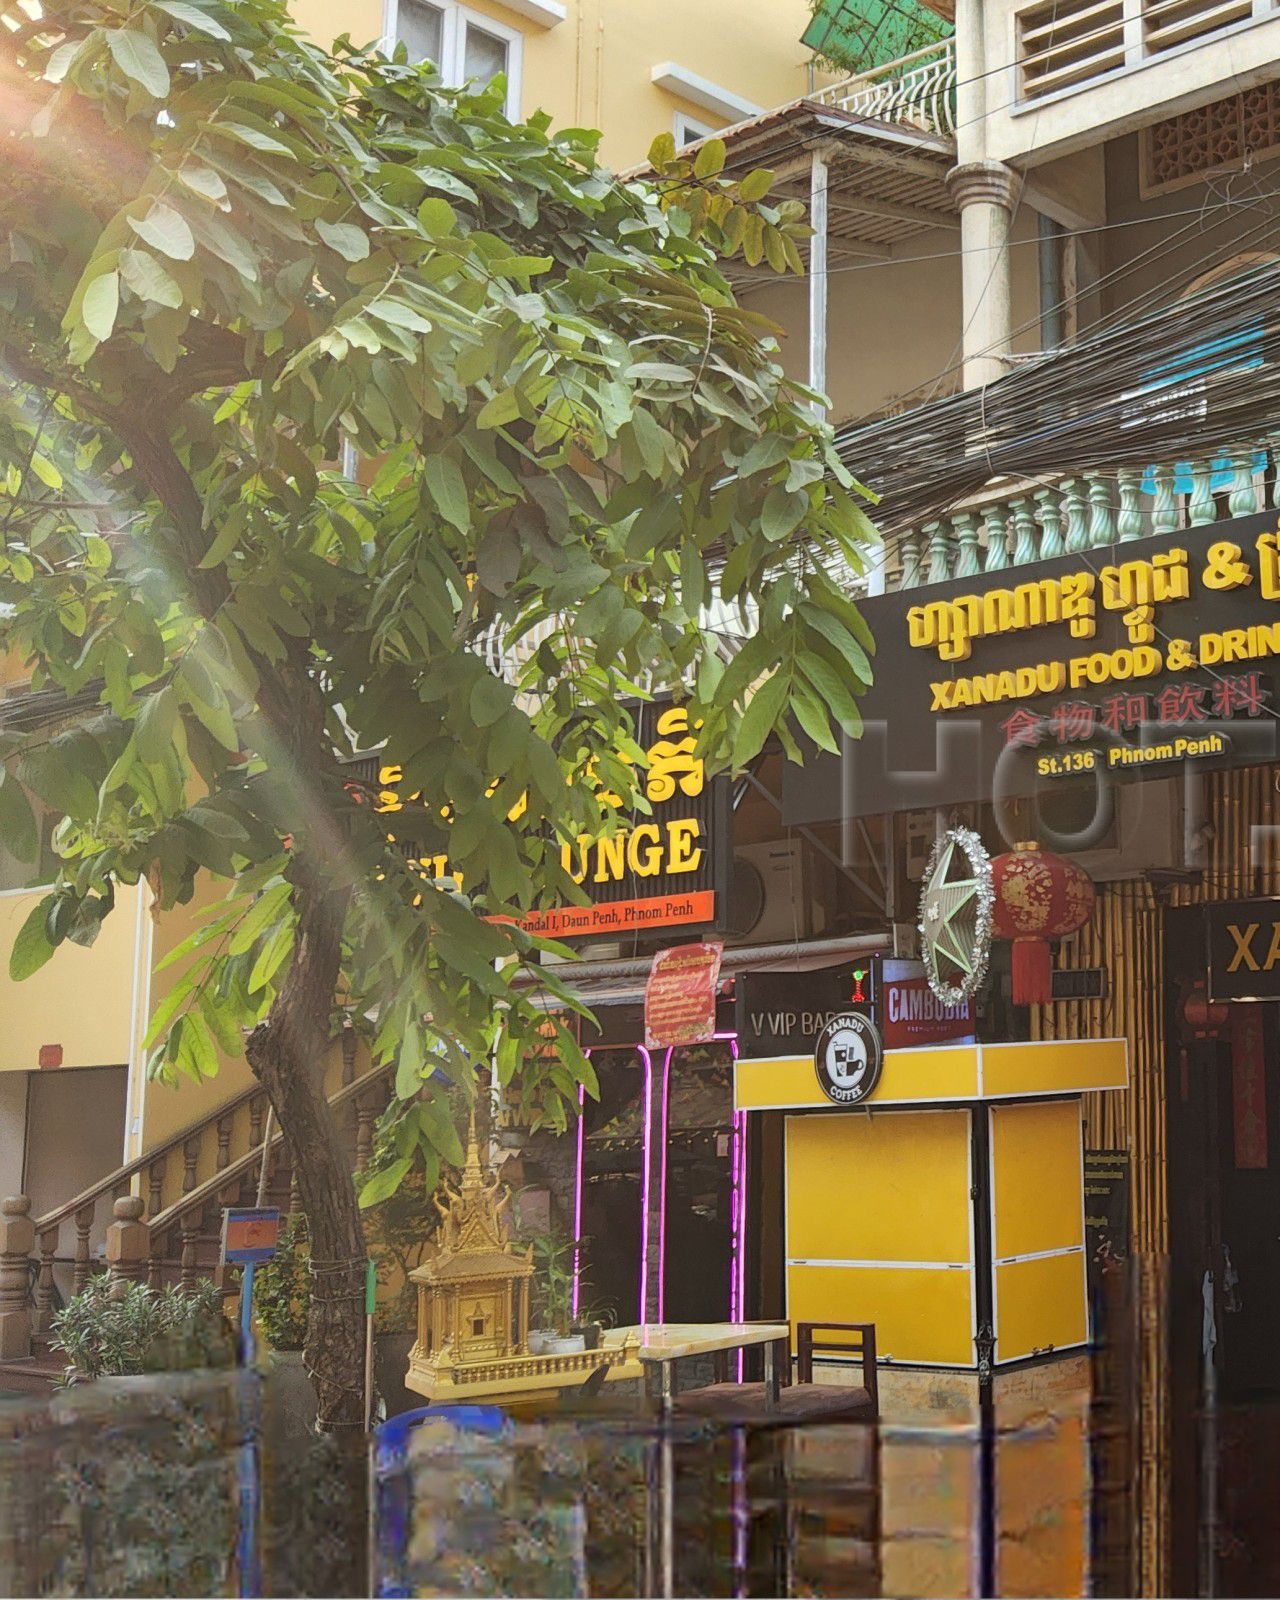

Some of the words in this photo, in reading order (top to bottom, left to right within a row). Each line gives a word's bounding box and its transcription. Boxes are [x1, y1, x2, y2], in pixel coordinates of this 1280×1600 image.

[1202, 541, 1254, 592] &
[931, 662, 1067, 712] XANADU
[1069, 645, 1162, 691] FOOD
[1165, 640, 1198, 672] &
[1001, 673, 1265, 748] 食物和飲料
[1037, 752, 1095, 778] St.136
[1109, 740, 1173, 768] Phnom
[1173, 735, 1223, 760] Penh
[558, 817, 702, 886] UNGE
[562, 913, 590, 929] Daun
[592, 909, 621, 925] Penh,
[624, 906, 662, 921] Phnom
[665, 900, 694, 917] Penh
[767, 1011, 797, 1036] VIP
[826, 1017, 865, 1037] XANADU
[830, 1084, 863, 1101] COFFEE
